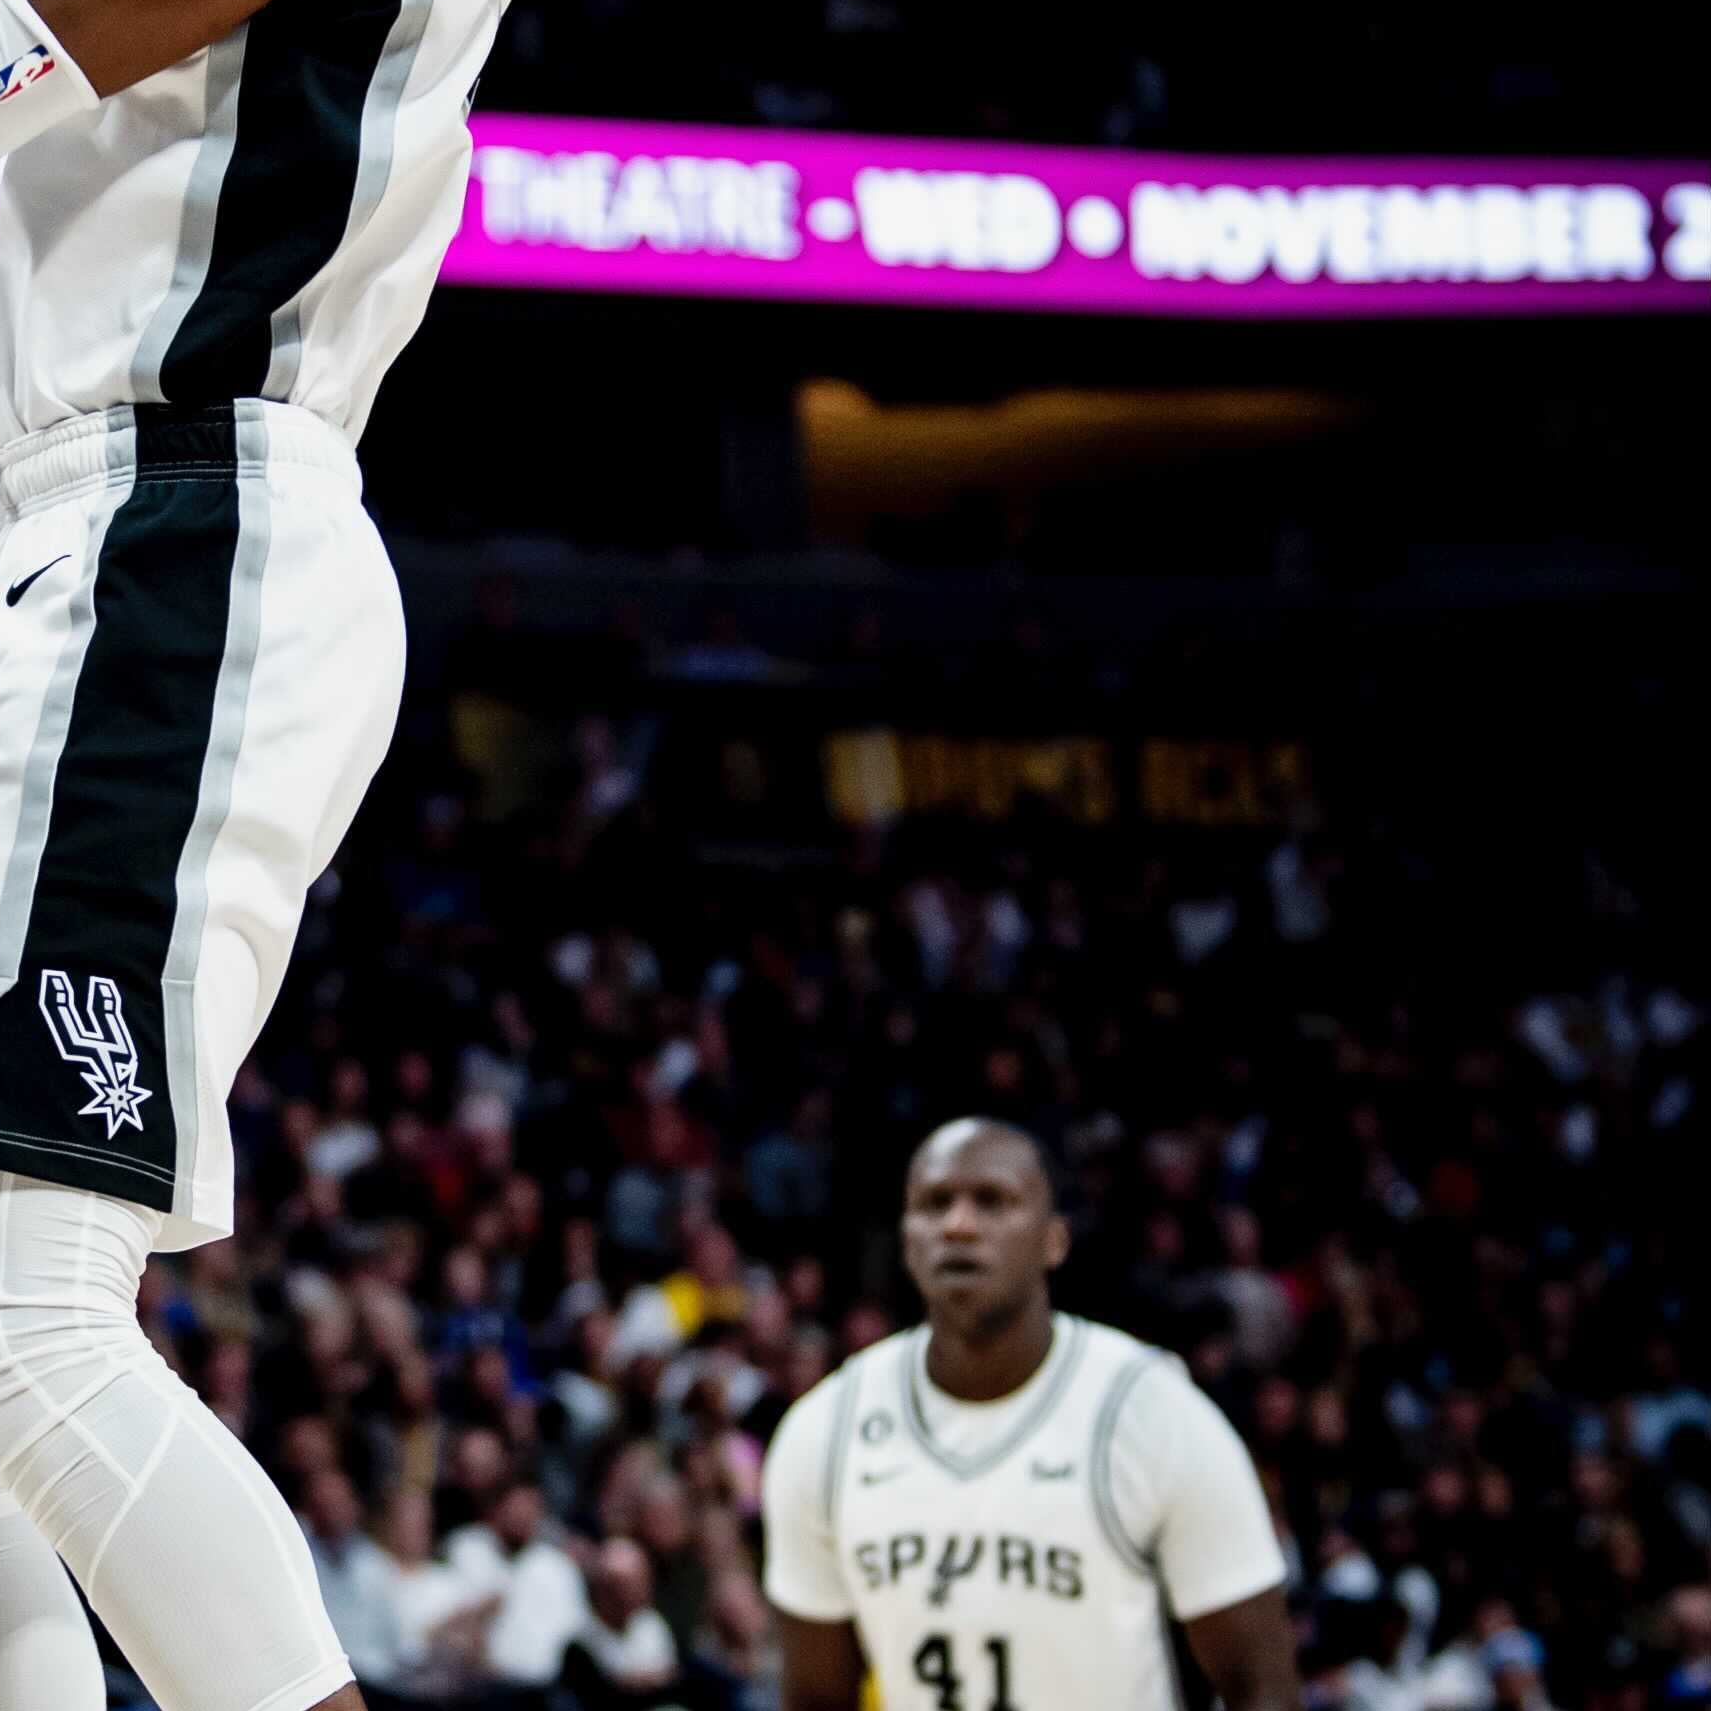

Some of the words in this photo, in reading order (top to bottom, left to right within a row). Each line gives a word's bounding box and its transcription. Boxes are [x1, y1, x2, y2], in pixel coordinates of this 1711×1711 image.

[475, 145, 803, 261] THEATRE
[854, 166, 1063, 273] WED
[1129, 181, 1656, 284] NOVEMBER
[855, 1531, 1085, 1608] SPURS
